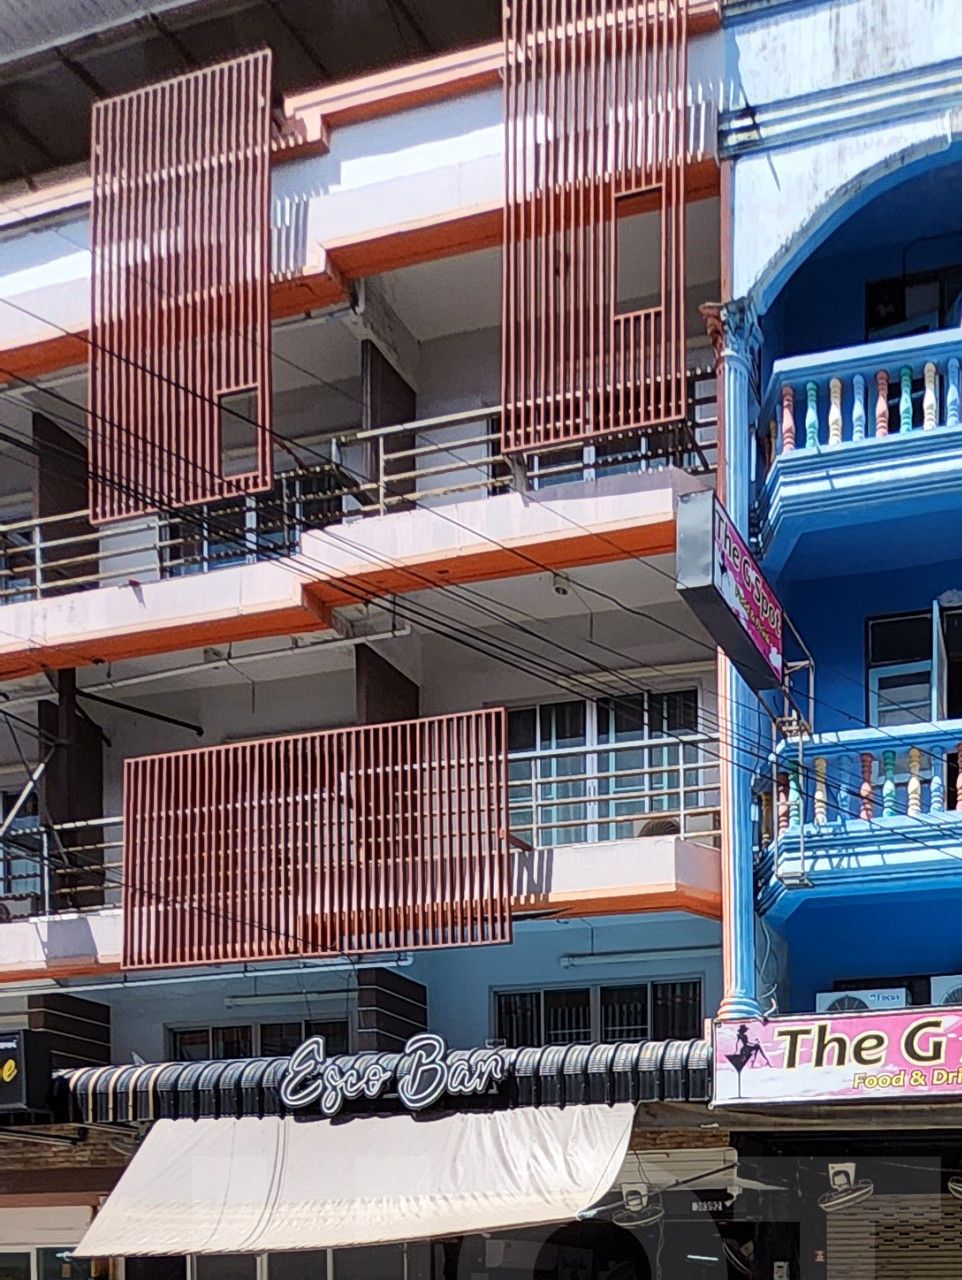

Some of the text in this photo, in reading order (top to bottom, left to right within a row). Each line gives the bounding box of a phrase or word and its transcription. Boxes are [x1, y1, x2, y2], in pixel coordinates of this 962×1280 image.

[775, 1022, 888, 1069] The
[901, 1016, 947, 1067] G
[280, 1034, 503, 1115] Esco Bar
[852, 1070, 905, 1089] Food
[910, 1071, 926, 1087] &
